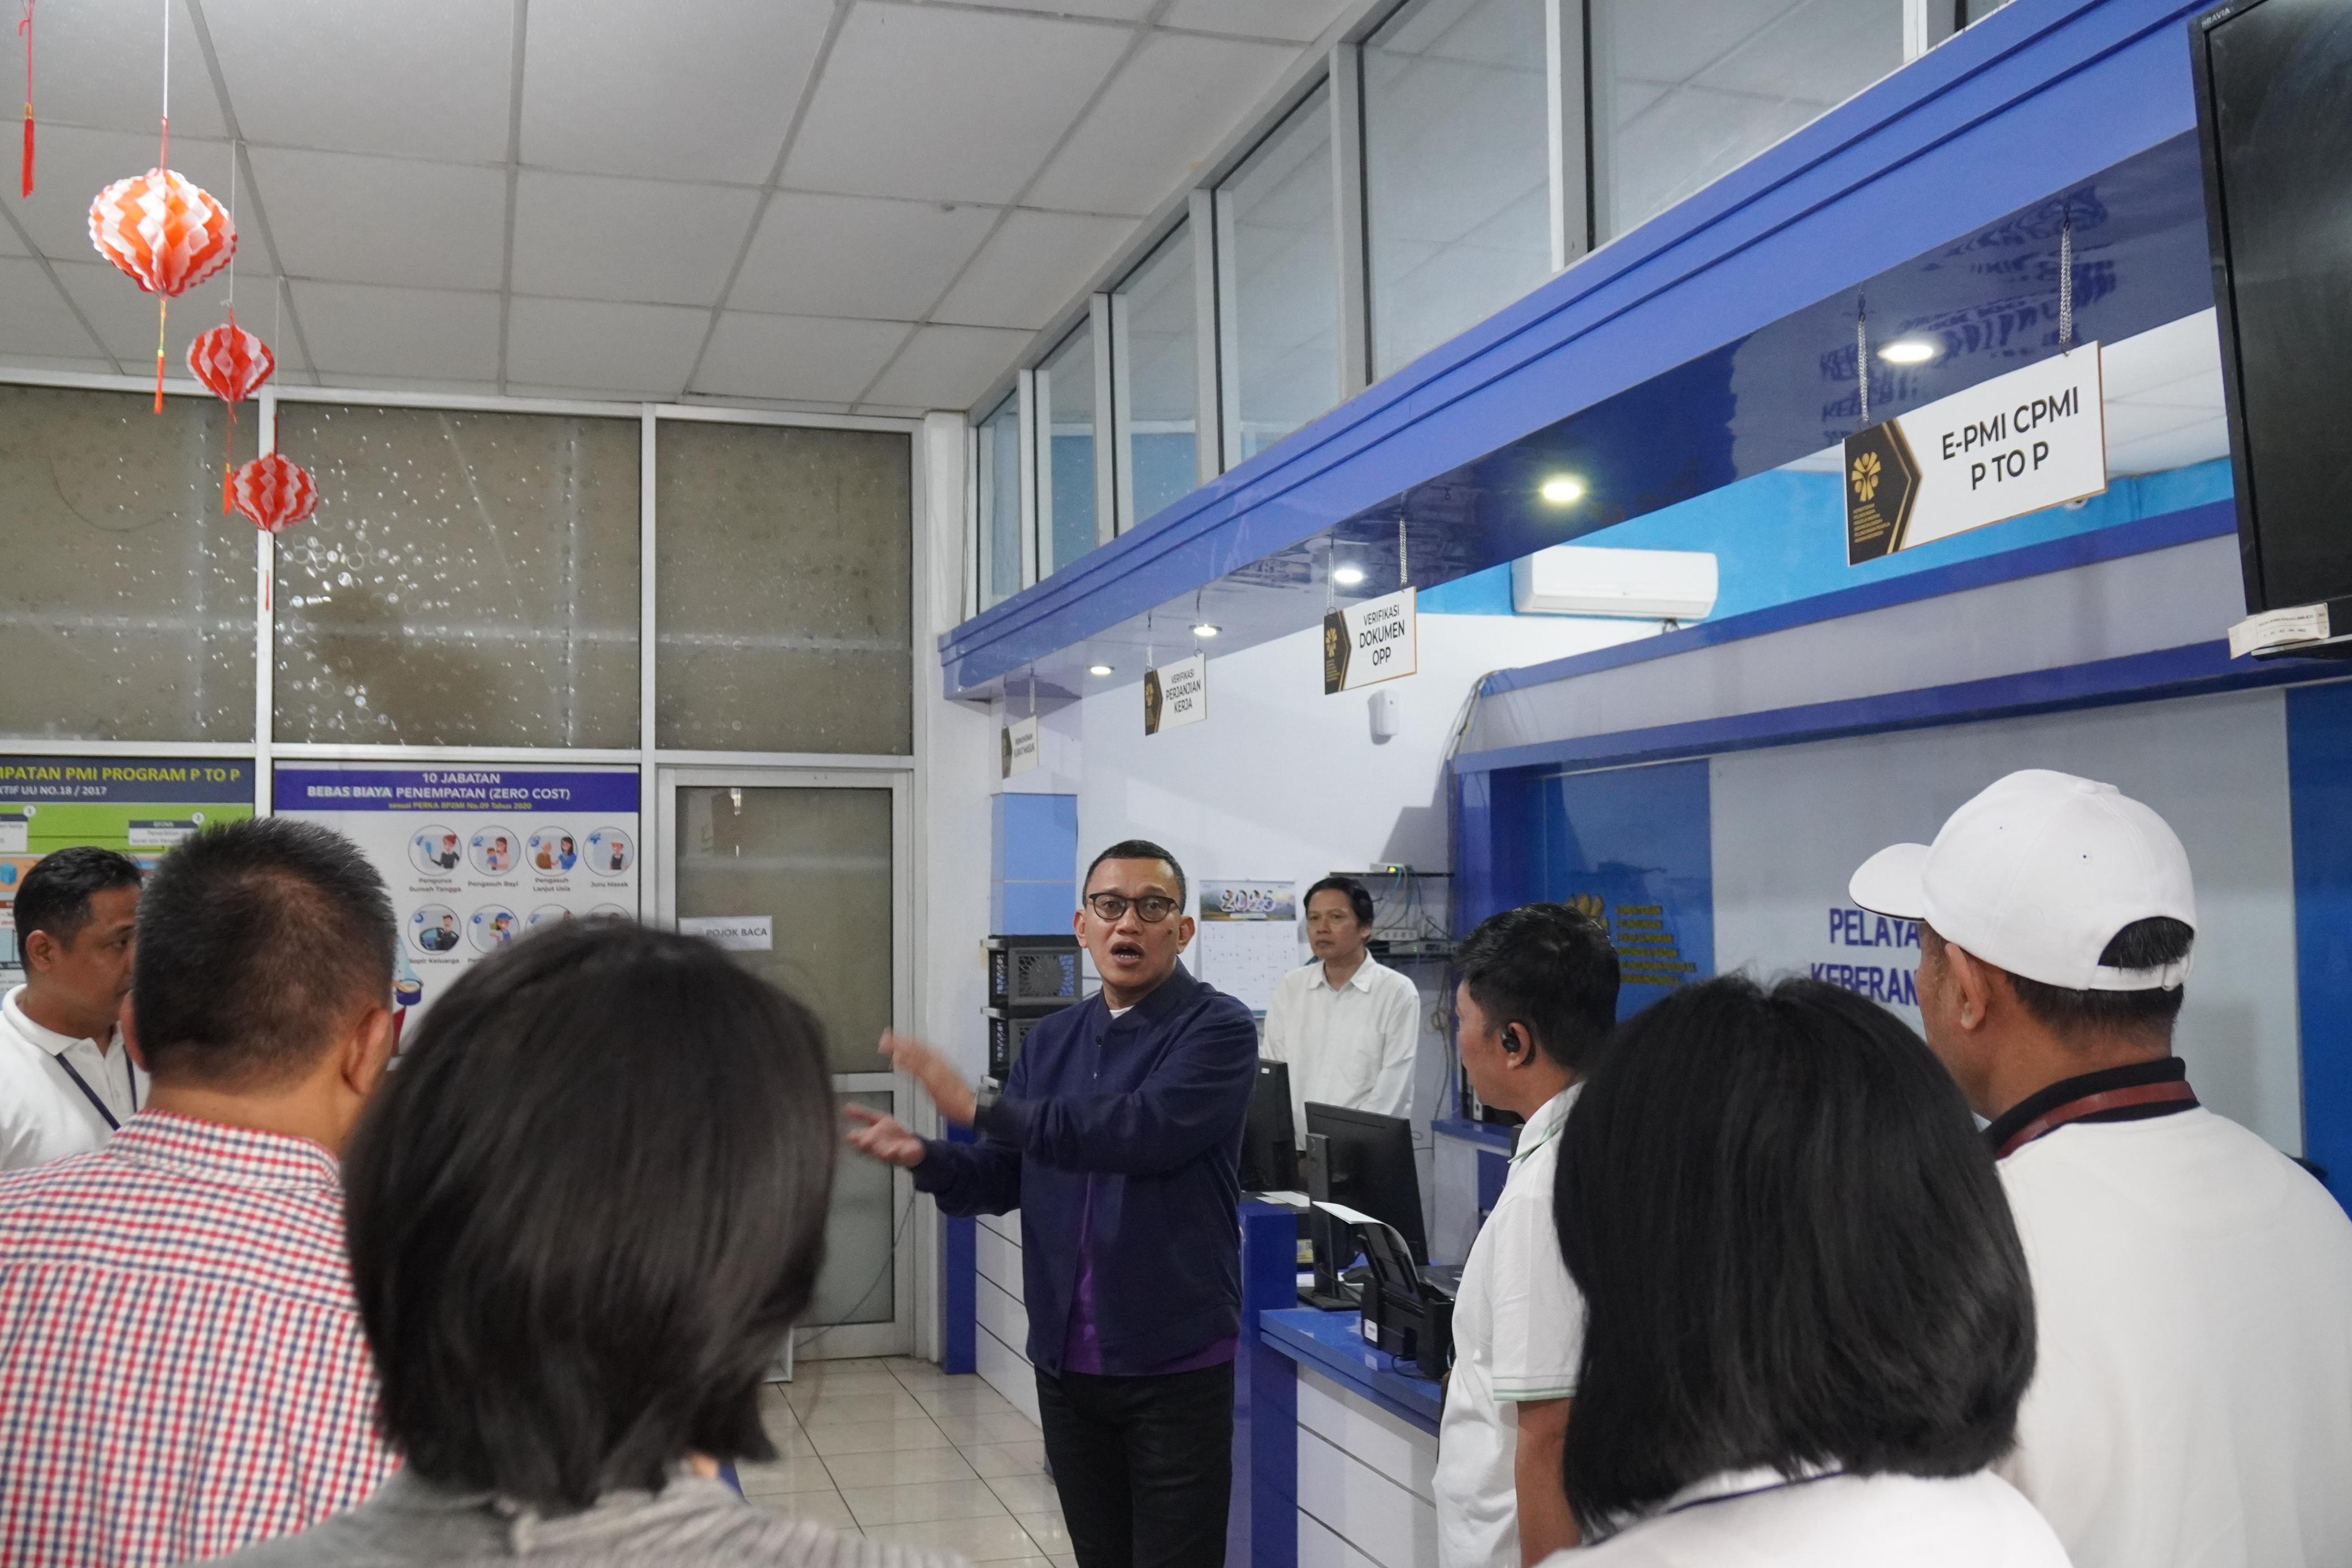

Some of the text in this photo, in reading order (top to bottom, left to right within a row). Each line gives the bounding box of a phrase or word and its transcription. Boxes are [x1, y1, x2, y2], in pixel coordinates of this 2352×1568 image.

[2201, 7, 2230, 28] BRAVIA
[1943, 386, 2078, 460] E-PMI CPMI
[1971, 441, 2049, 491] P TO P
[1363, 604, 1399, 626] VERIFIKASI
[1359, 620, 1405, 648] DOKUMEN
[1373, 647, 1391, 666] OPP
[1171, 669, 1194, 683] VERIFIKASI
[1166, 679, 1201, 700] PERJANJIAN
[1174, 698, 1192, 713] KERJA
[0, 766, 241, 782] PATAN PMI PROGRAM P TO P
[422, 773, 500, 784] 10 JABATAN
[21, 786, 37, 795] UU
[82, 786, 107, 796] 2017
[307, 786, 570, 800] BEBAS BIAYA PENEMPATAN (ZERO COST)
[1221, 889, 1276, 912] 2025
[707, 928, 767, 937] POJOK BACA
[1829, 908, 1921, 948] PELAYA
